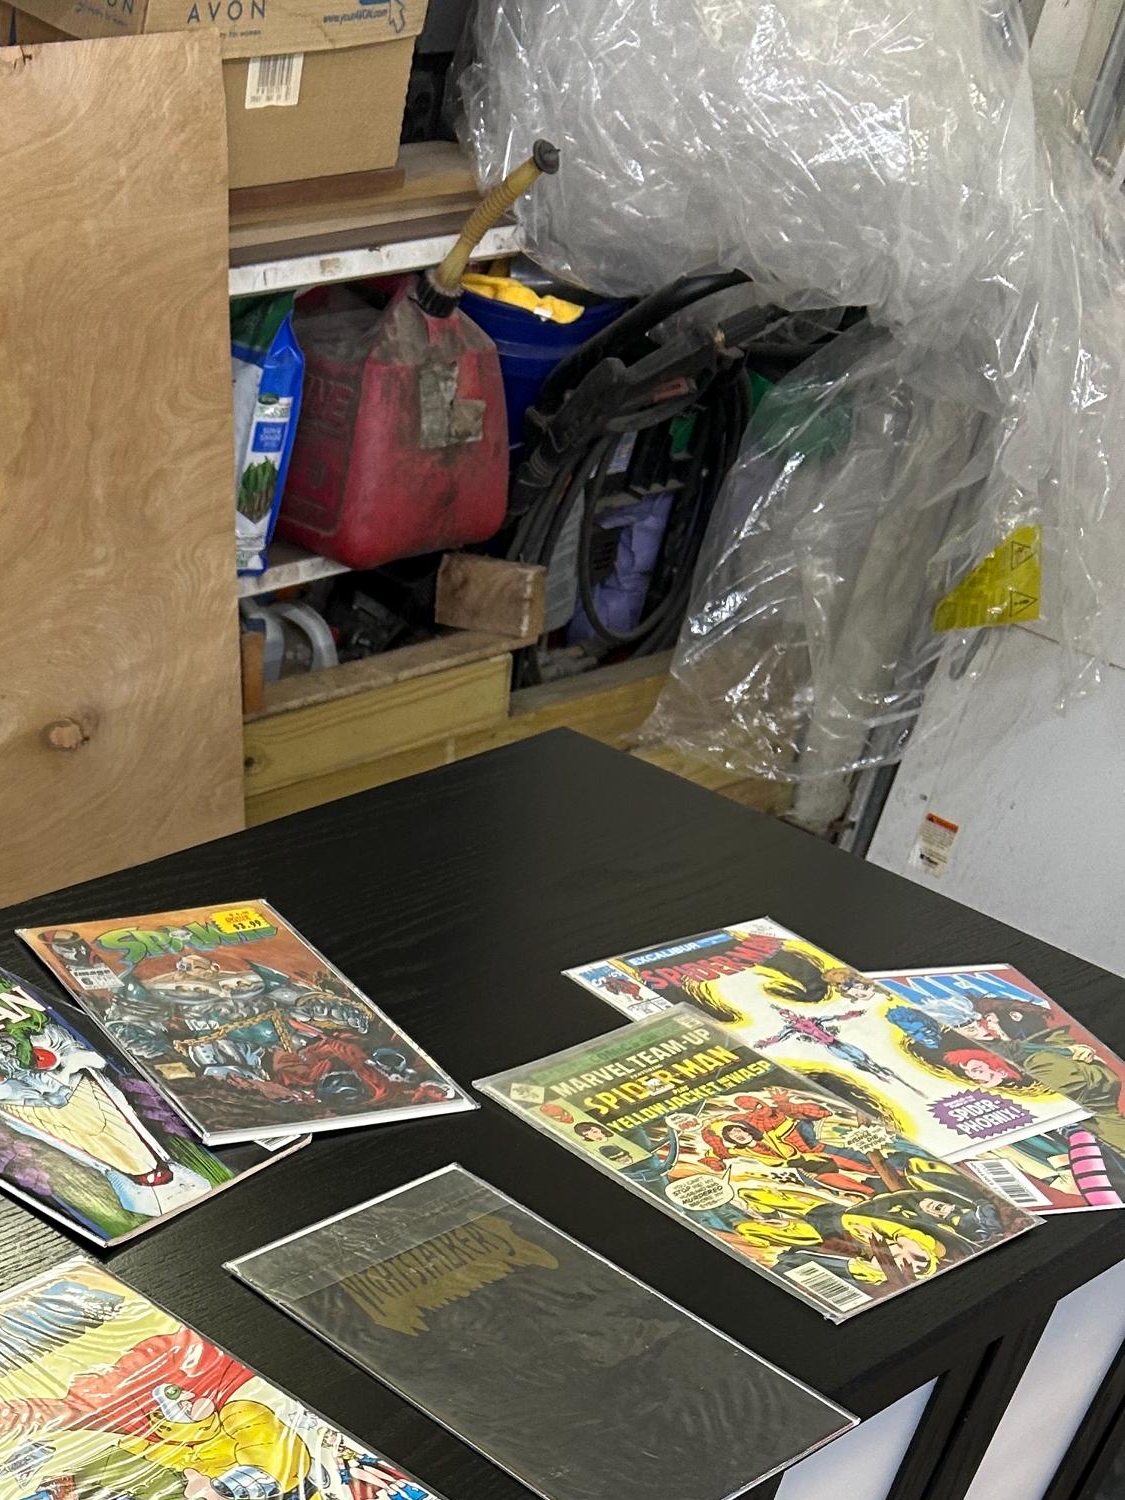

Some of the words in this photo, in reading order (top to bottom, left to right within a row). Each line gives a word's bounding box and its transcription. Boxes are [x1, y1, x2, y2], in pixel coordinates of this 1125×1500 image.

[187, 0, 266, 23] AVON
[627, 941, 700, 966] EXCALIBUR
[550, 1053, 636, 1098] MARVEL
[629, 1028, 711, 1073] TEAM-UP
[729, 1060, 774, 1090] WASP
[584, 1045, 739, 1117] SPIDER-MAN
[948, 1099, 1001, 1122] SPIDER-
[956, 1105, 1025, 1136] PHOENIX!
